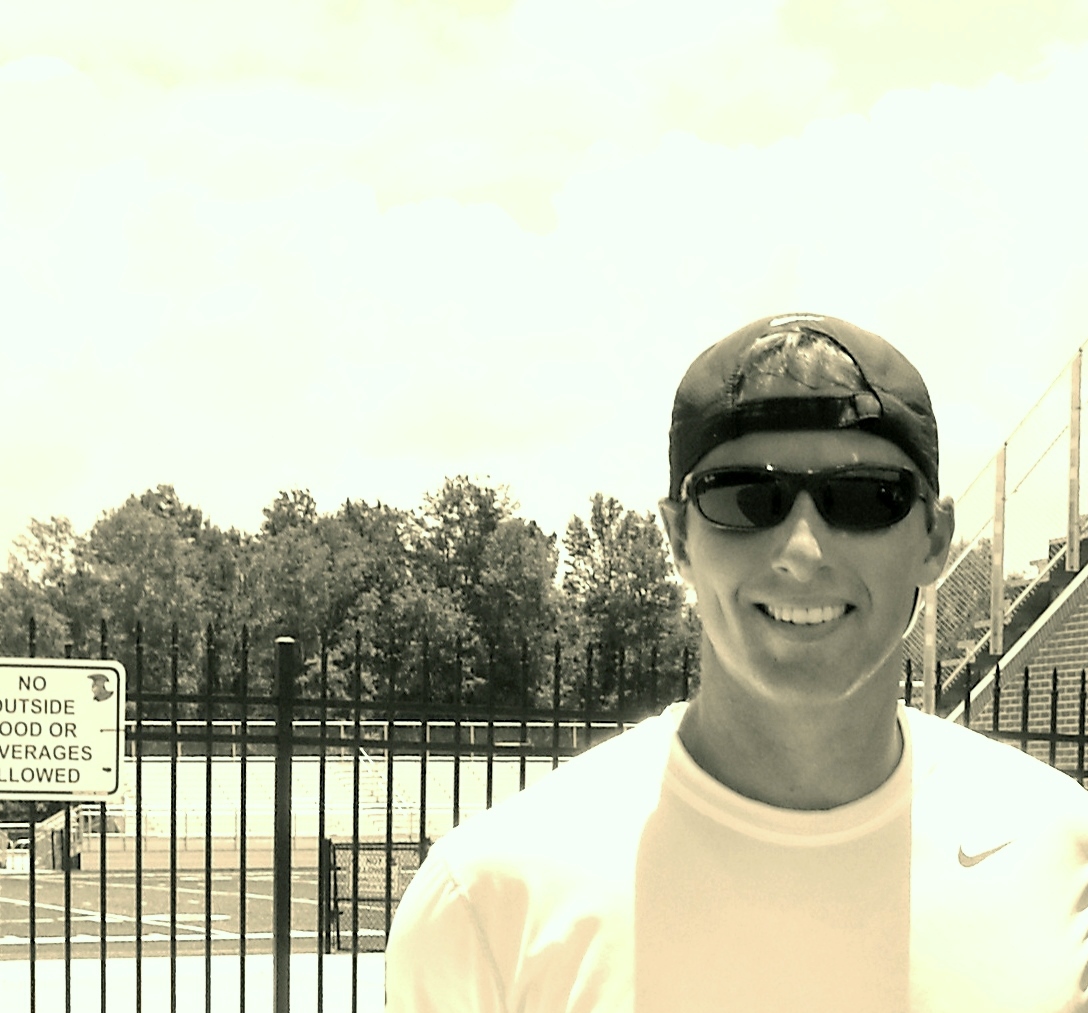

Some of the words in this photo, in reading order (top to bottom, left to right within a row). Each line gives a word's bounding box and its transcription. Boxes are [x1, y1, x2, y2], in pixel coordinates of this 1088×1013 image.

[18, 675, 47, 692] NO
[0, 698, 75, 715] UTSIDE
[49, 722, 77, 738] OR
